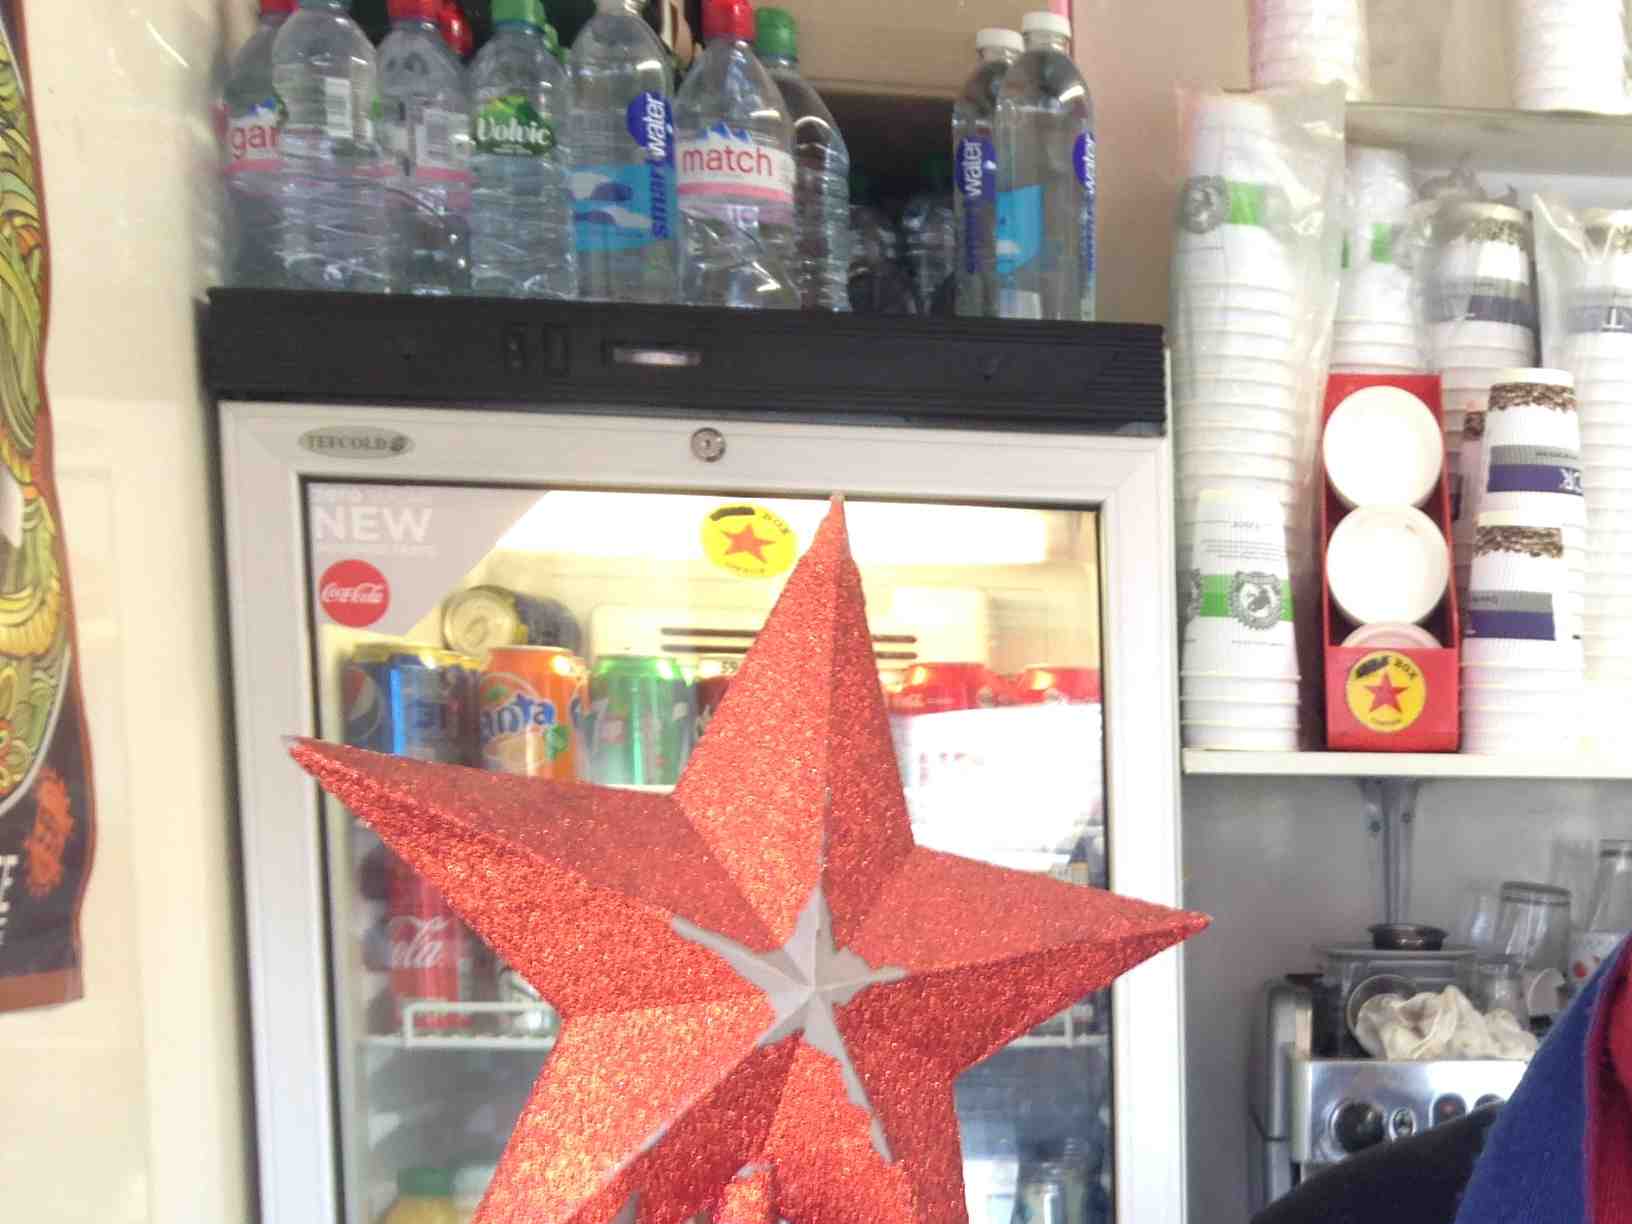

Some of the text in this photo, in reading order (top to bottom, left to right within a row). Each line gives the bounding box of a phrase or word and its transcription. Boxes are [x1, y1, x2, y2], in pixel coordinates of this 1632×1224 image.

[477, 117, 551, 146] Volvic
[683, 145, 774, 177] match
[314, 506, 433, 544] NEW
[321, 583, 387, 604] Coca-Cola
